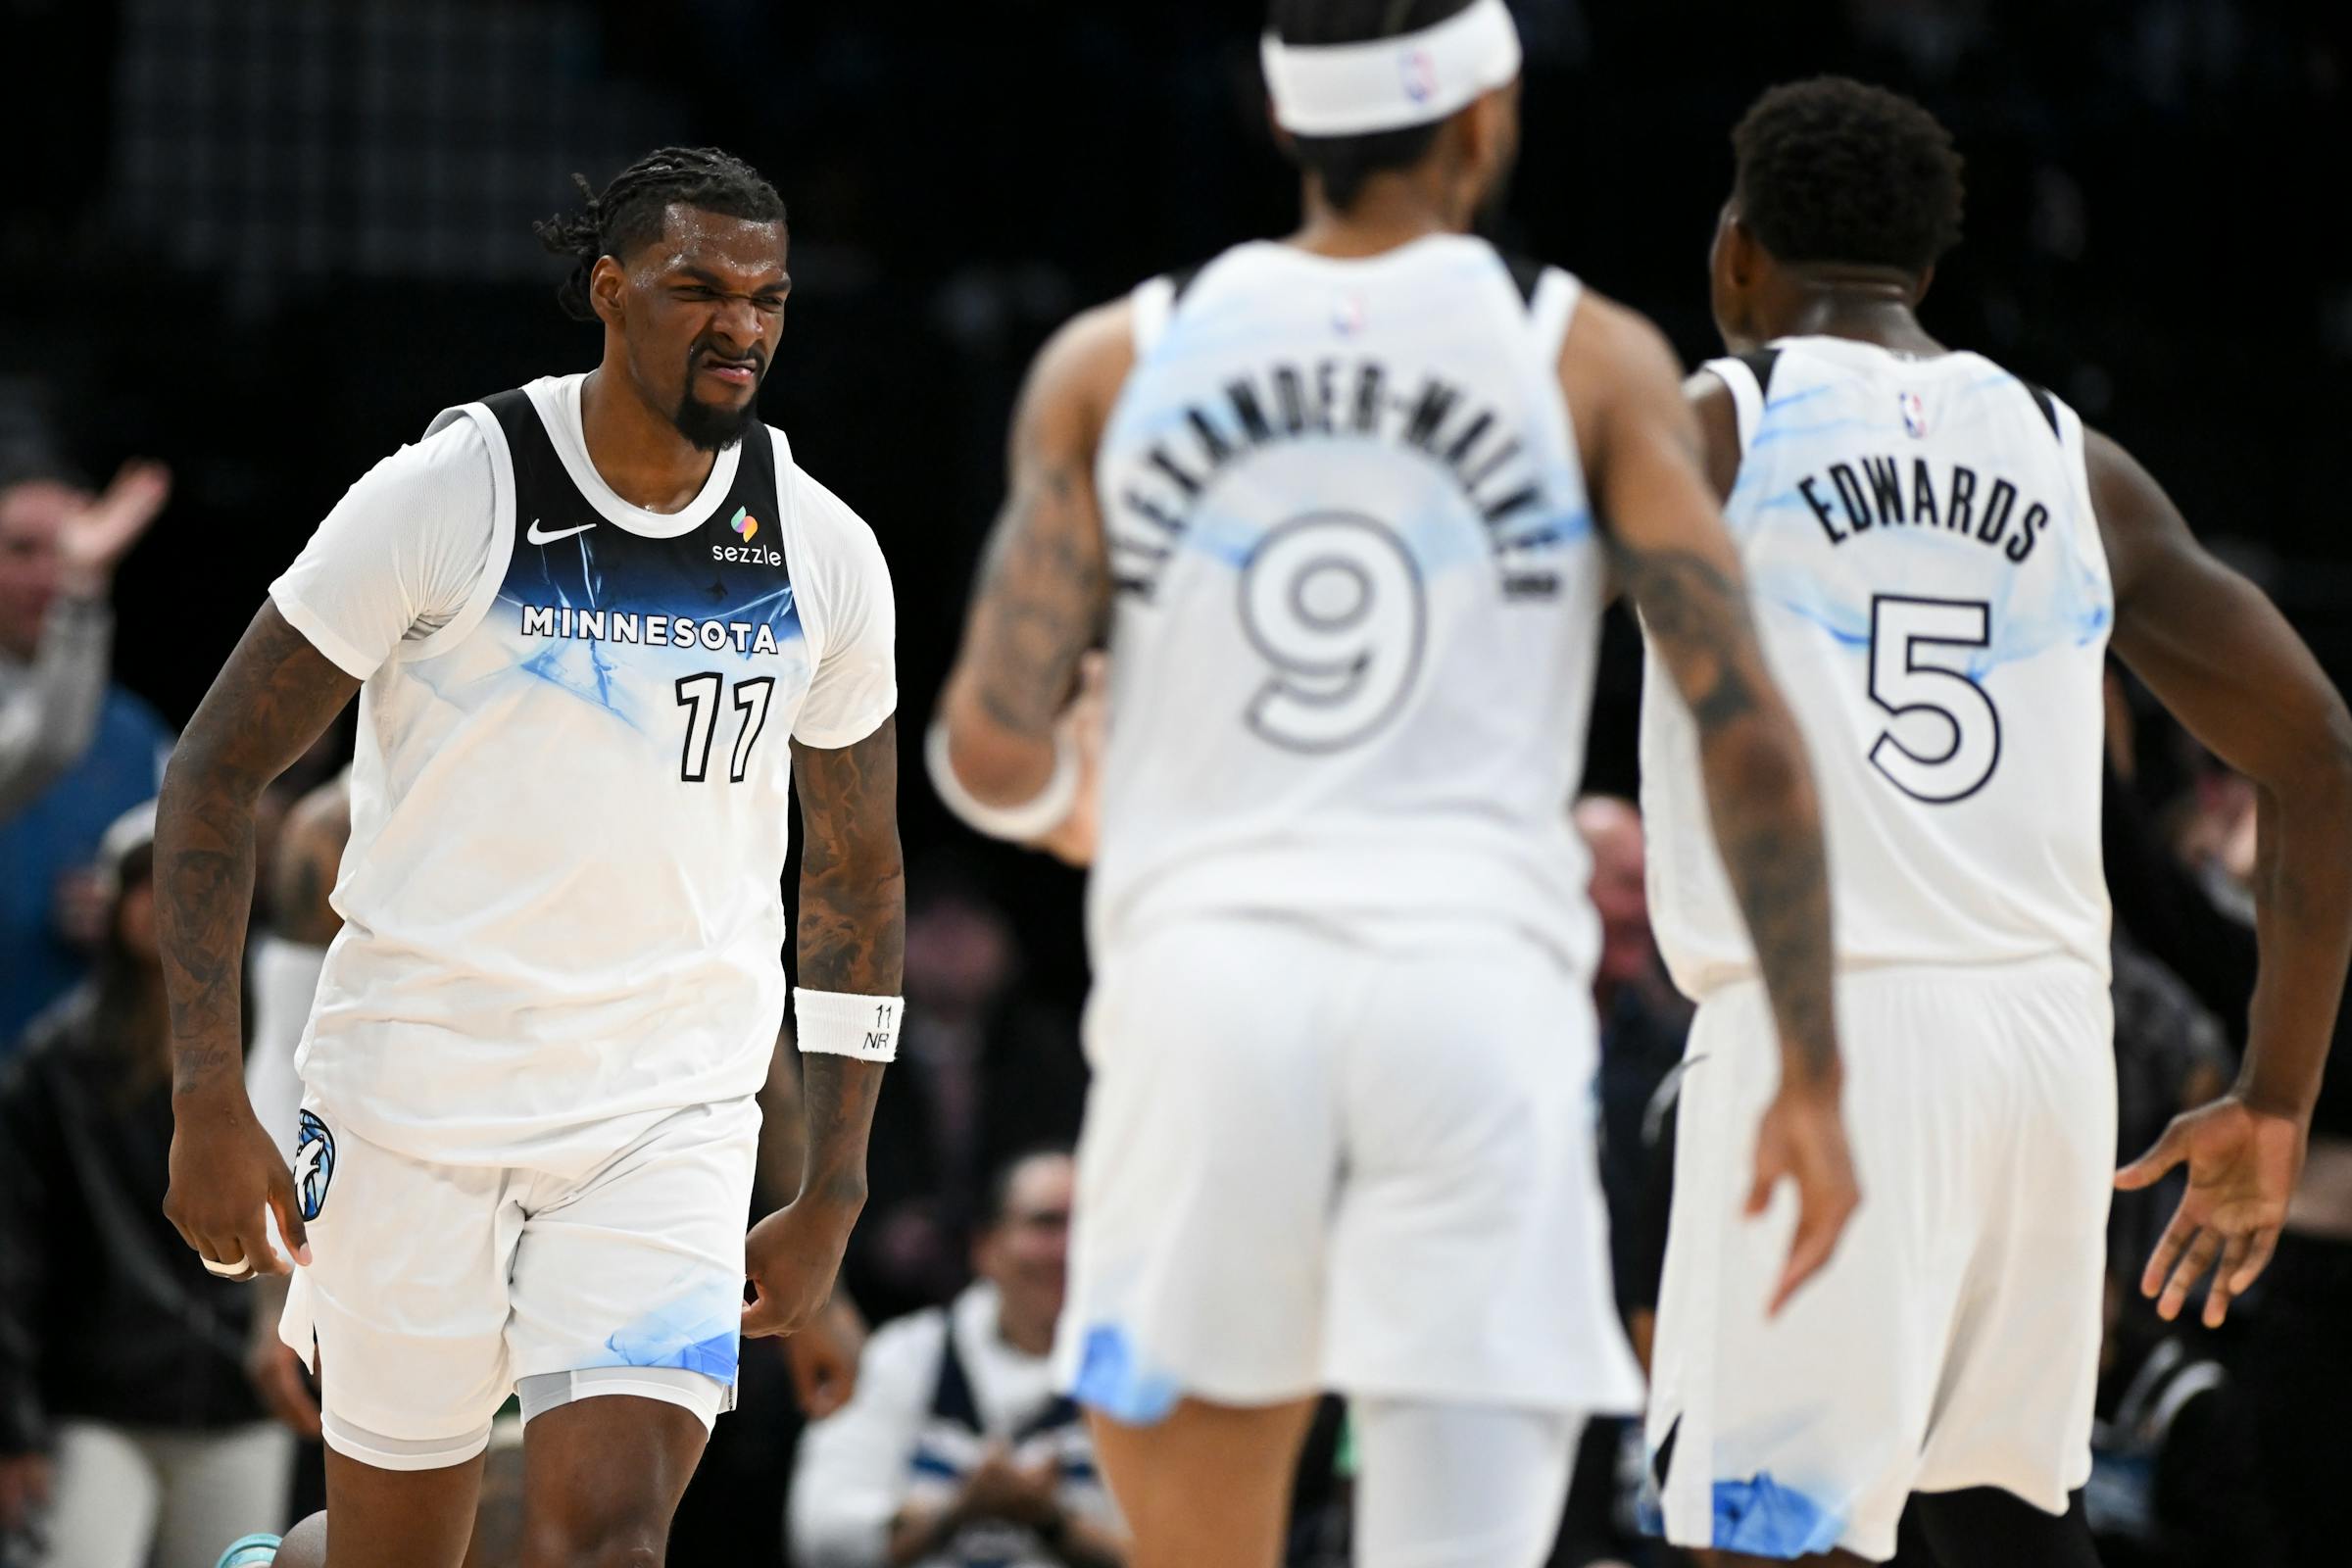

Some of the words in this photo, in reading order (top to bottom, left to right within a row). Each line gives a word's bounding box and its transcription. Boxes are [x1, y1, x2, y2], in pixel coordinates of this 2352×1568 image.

[1796, 456, 2049, 564] EDWARDS
[712, 545, 782, 566] sezzle
[521, 606, 779, 655] MINNESOTA
[1238, 509, 1428, 755] 9
[675, 671, 775, 783] 11
[1868, 594, 2001, 805] 5
[862, 1032, 890, 1050] NR
[876, 1004, 892, 1029] 11
